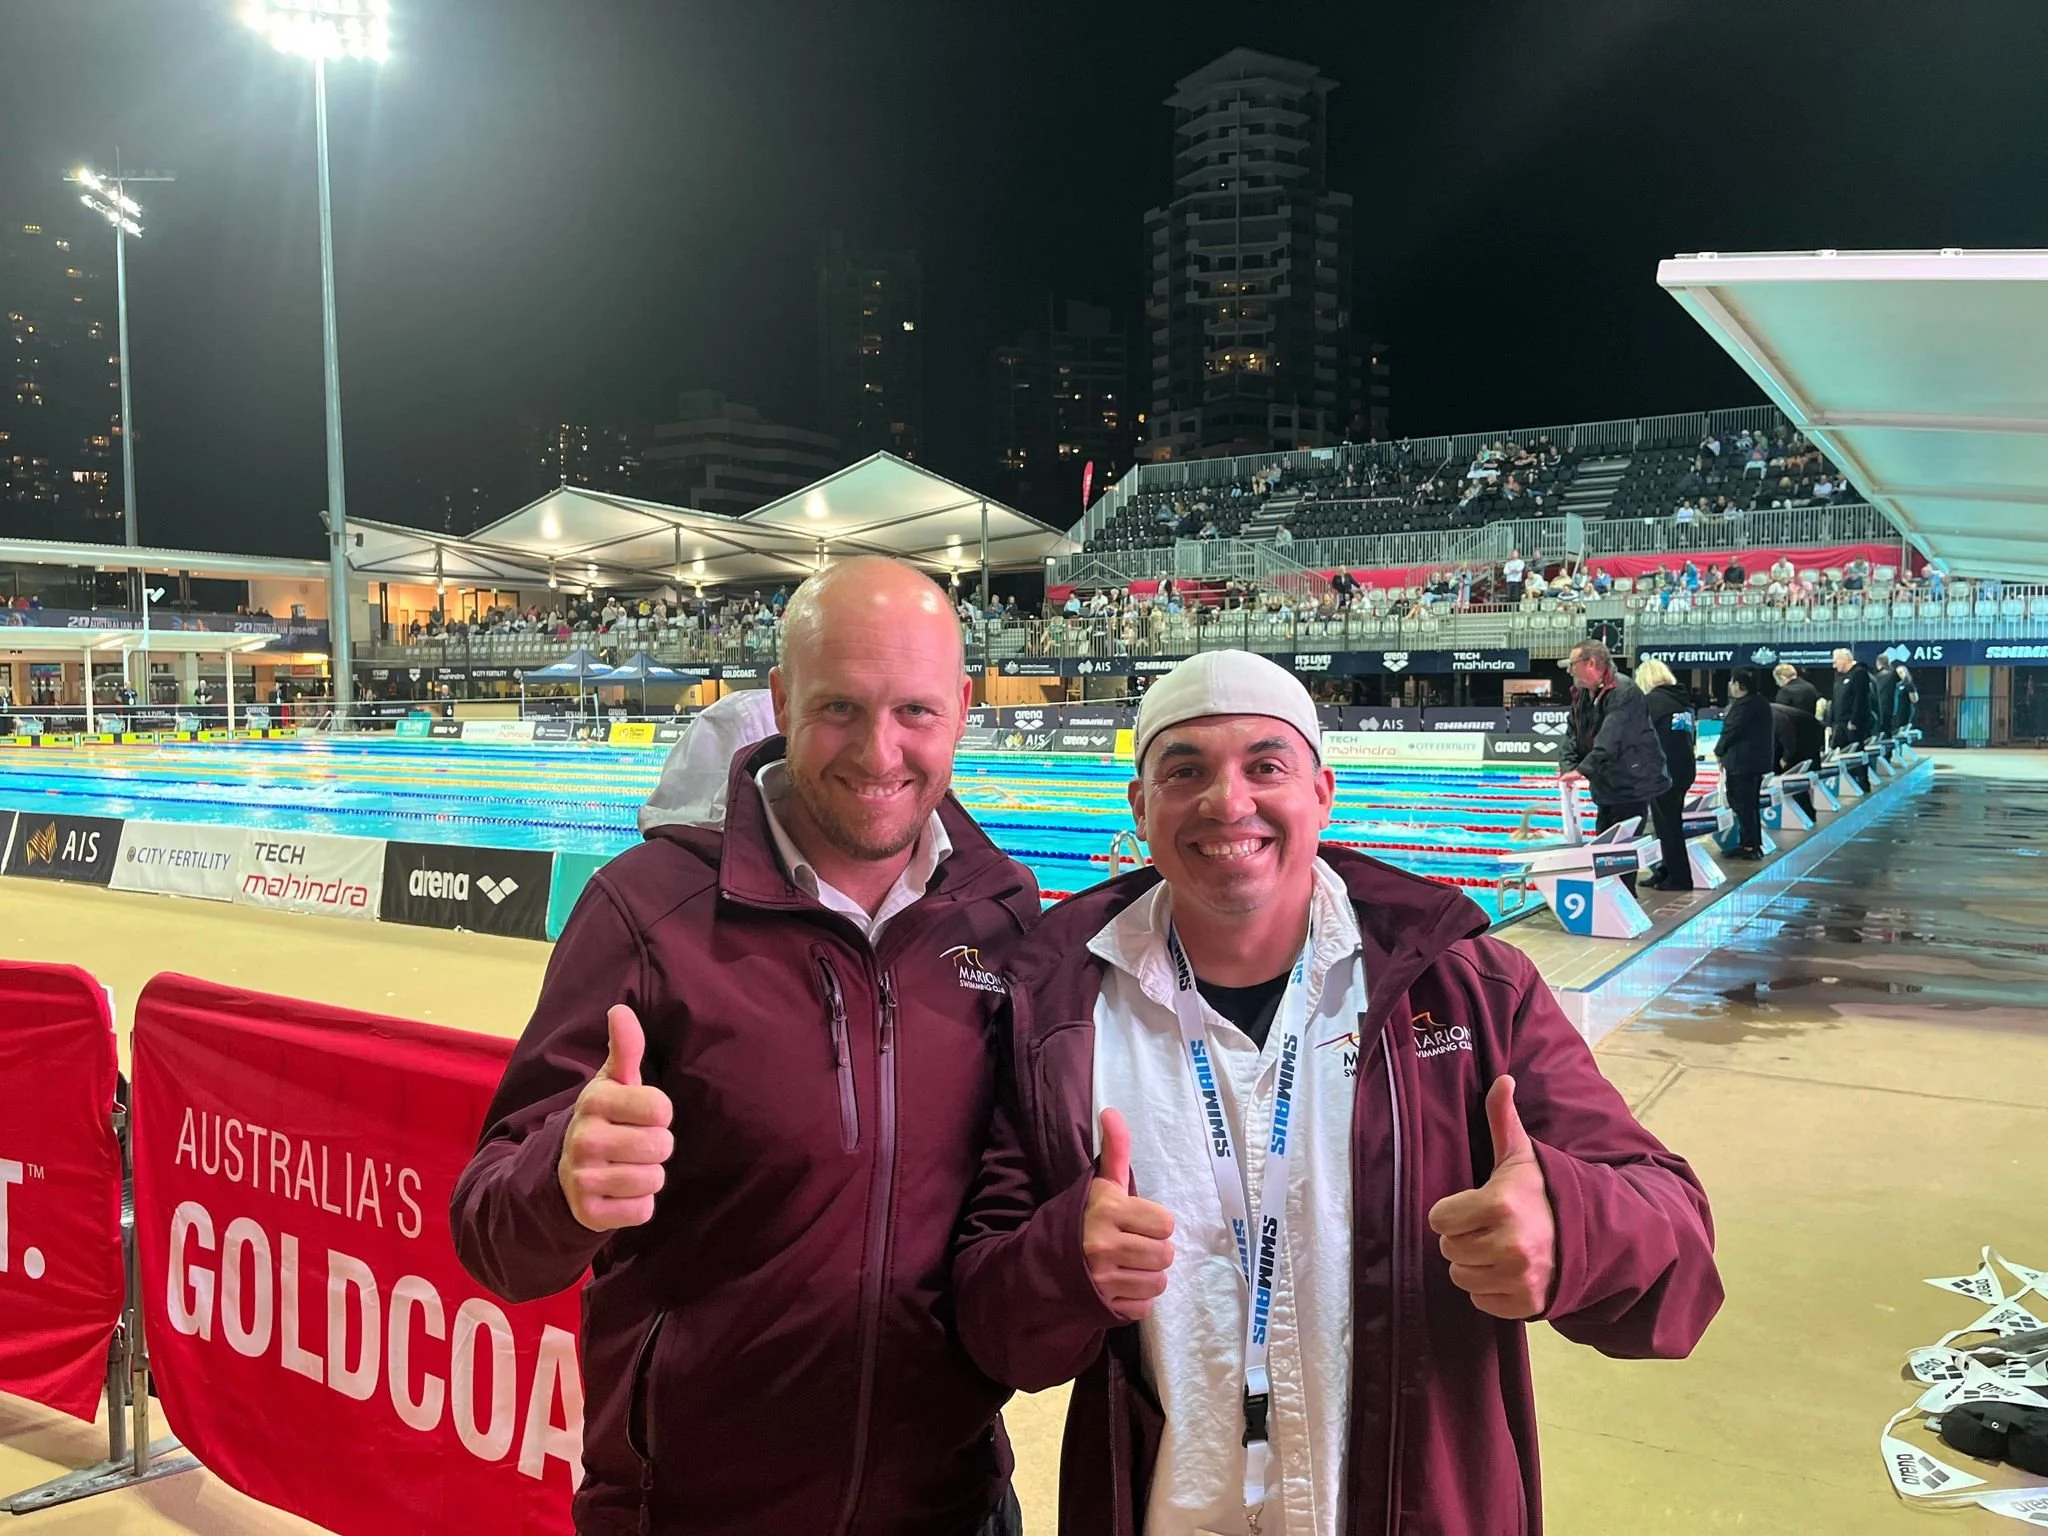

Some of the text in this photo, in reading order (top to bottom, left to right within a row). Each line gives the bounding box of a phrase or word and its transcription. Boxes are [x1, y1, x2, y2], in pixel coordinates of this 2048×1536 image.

[1383, 652, 1408, 660] arena
[1453, 652, 1480, 660] TECH
[1651, 651, 1733, 662] CITY FERTILITY
[1914, 646, 1943, 660] AIS
[1986, 646, 2048, 659] SWIMA
[1095, 661, 1112, 671] AIS
[1452, 660, 1515, 670] mahindra
[722, 669, 757, 678] GOLDCOAST.
[1014, 710, 1043, 719] arena
[1382, 720, 1404, 730] AIS
[1434, 721, 1496, 730] SWIMAUS
[1025, 735, 1045, 745] AIS
[1062, 735, 1088, 745] arena
[1329, 735, 1357, 744] TECH
[1327, 745, 1396, 756] mahindra
[1494, 742, 1530, 753] arena
[1763, 807, 1777, 820] 6
[62, 830, 100, 863] AIS
[137, 847, 231, 871] CITY FERTILITY
[254, 842, 305, 865] TECH
[242, 873, 368, 907] mahindra
[409, 868, 469, 901] arena
[1564, 893, 1586, 920] 9
[959, 965, 1002, 986] MARION
[960, 979, 992, 991] SWIMMING
[1416, 1043, 1457, 1059] WIMMING
[1190, 1039, 1231, 1158] SWIMAUS
[1270, 1033, 1298, 1157] SWIMAUS
[175, 1107, 423, 1238] AUSTRALIA'S
[1252, 1215, 1278, 1346] SWIMAUS
[167, 1200, 586, 1495] GOLDCOA
[1896, 1453, 1915, 1486] arena
